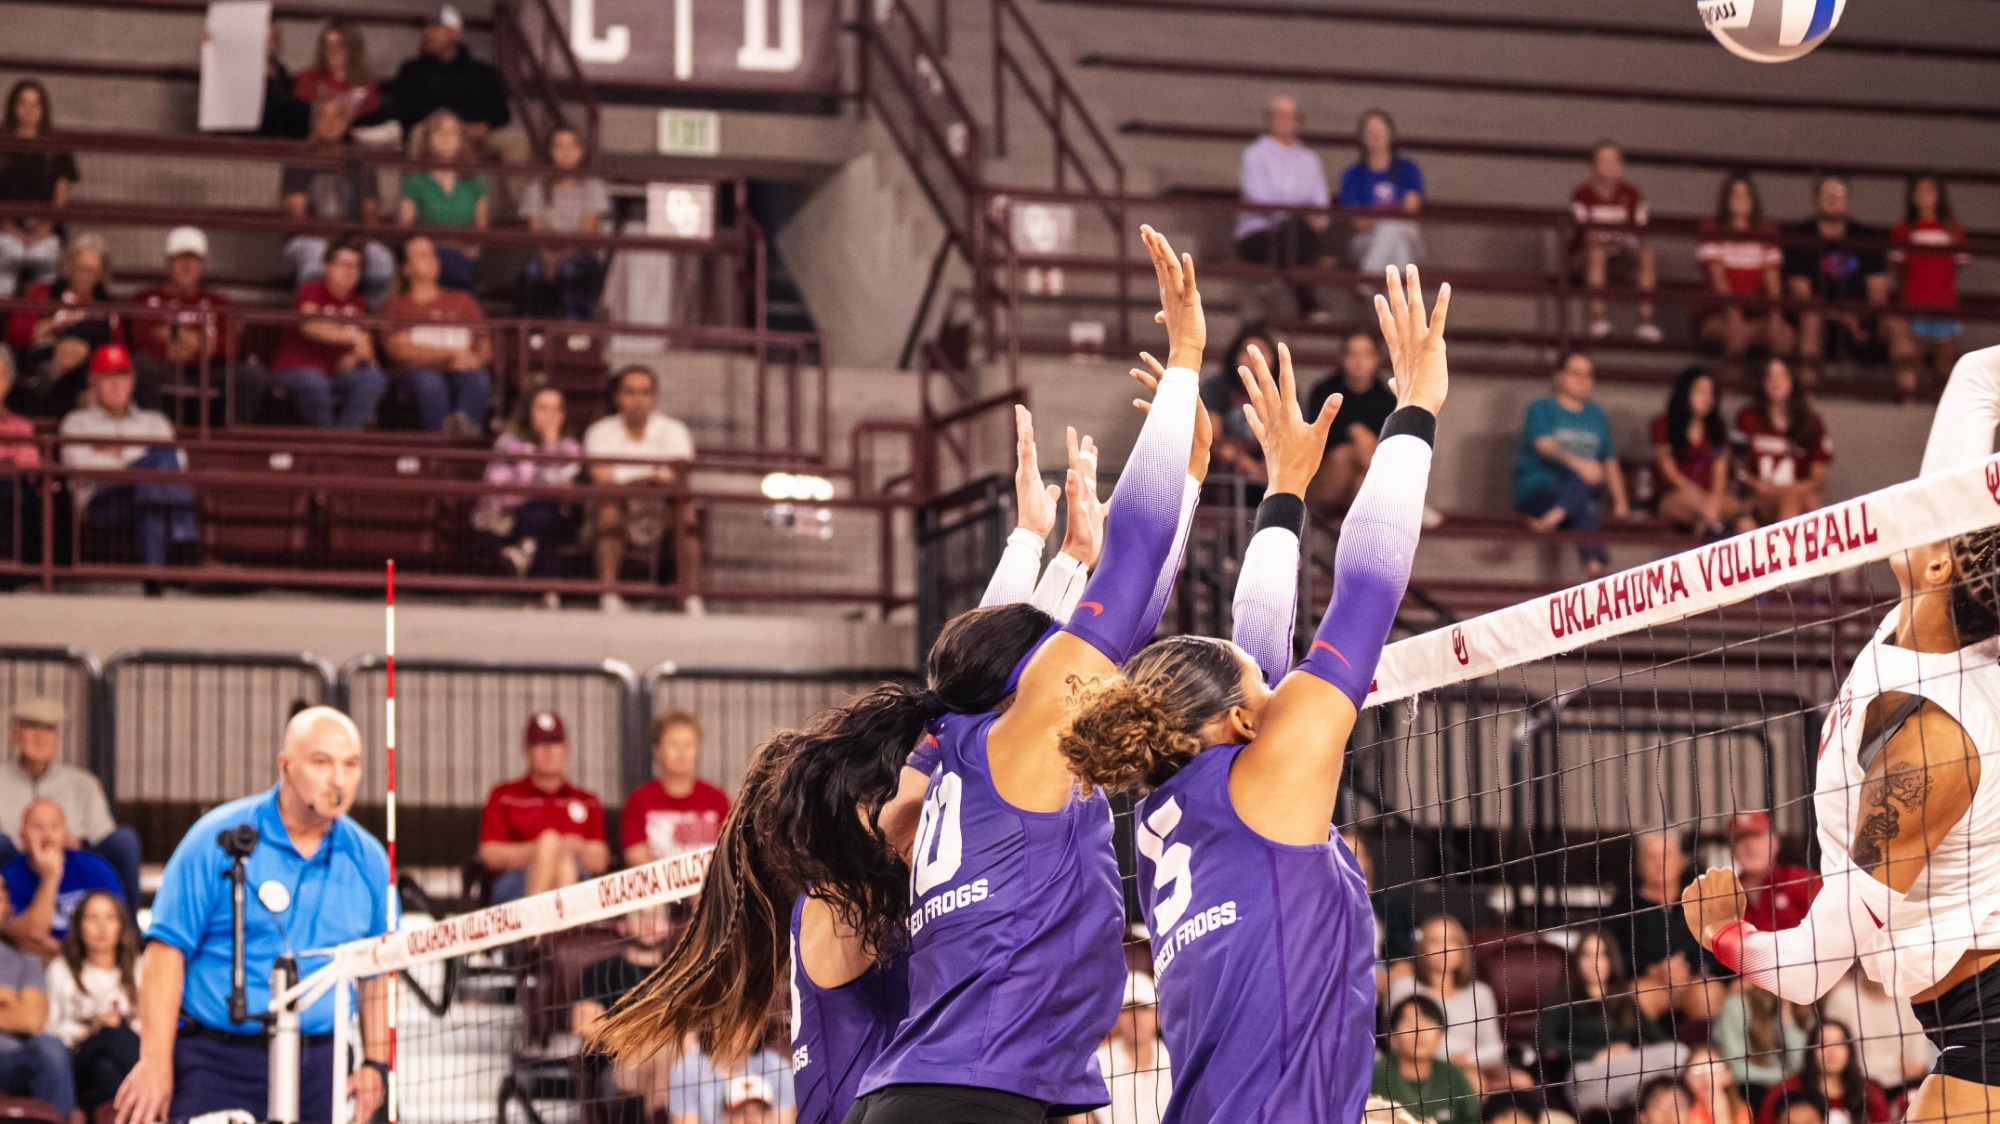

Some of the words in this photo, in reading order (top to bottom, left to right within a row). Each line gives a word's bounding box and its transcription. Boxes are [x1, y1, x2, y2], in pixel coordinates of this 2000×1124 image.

[1550, 560, 1689, 639] OKLAHOMA
[1697, 501, 1878, 593] VOLLEYBALL
[598, 866, 662, 909] OKLAHOMA
[924, 878, 988, 924] FROGS
[407, 923, 457, 956] OKLAHOMA
[461, 902, 522, 942] VOLLEYBALL
[1175, 900, 1237, 952] FROGS
